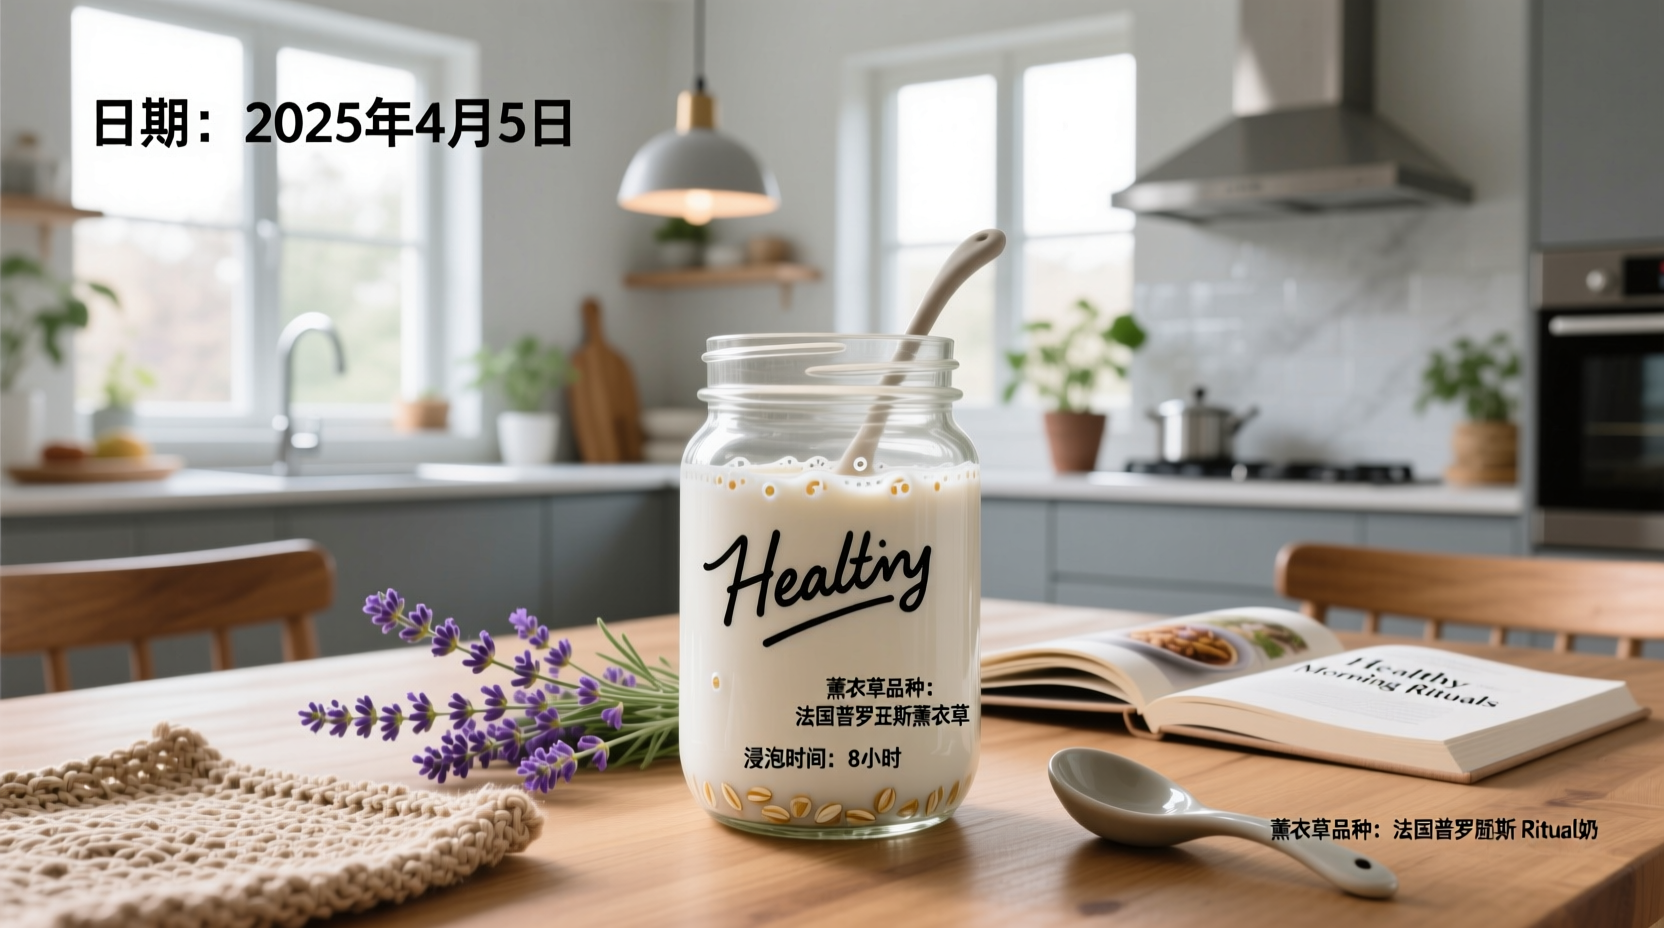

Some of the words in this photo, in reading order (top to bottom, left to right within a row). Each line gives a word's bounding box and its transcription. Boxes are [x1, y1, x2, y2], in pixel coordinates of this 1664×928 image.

[1294, 664, 1400, 692] Morning
[1405, 684, 1500, 708] Rituals
[1346, 656, 1470, 688] Healthy
